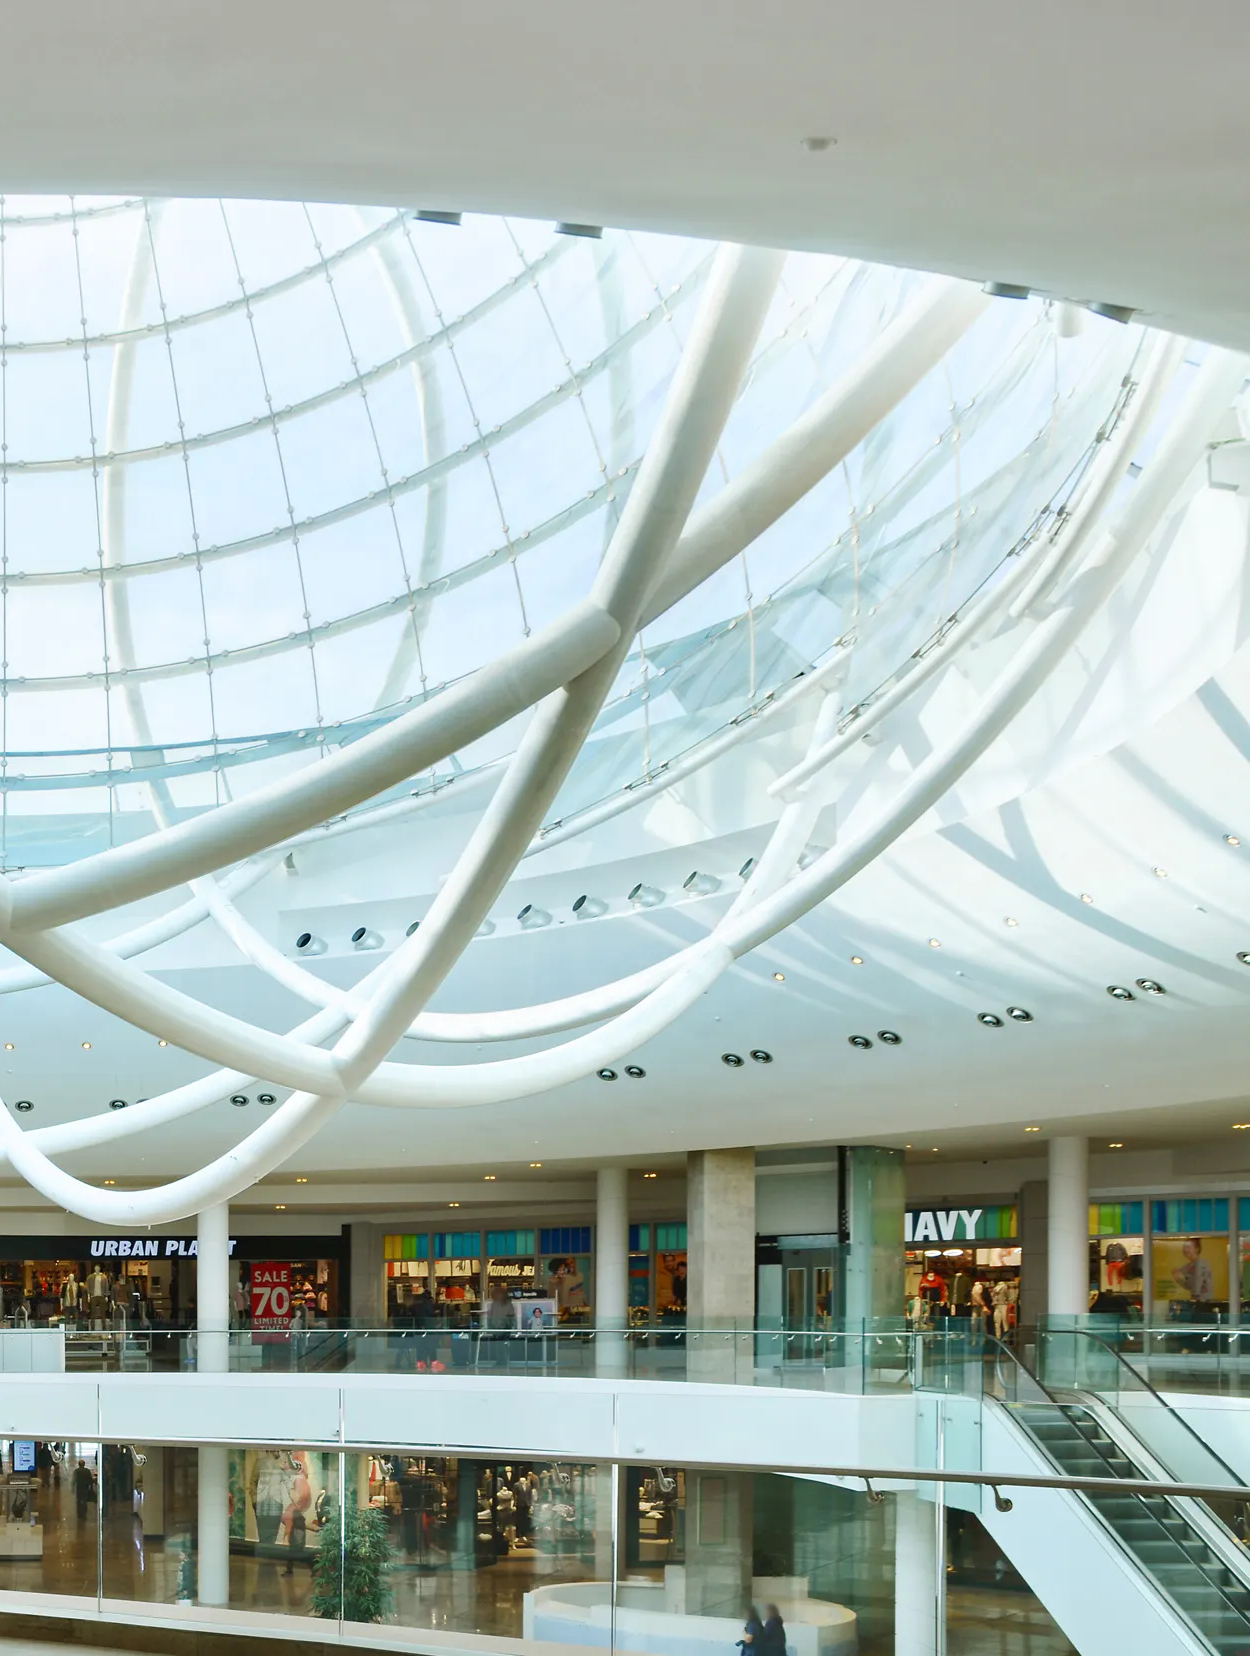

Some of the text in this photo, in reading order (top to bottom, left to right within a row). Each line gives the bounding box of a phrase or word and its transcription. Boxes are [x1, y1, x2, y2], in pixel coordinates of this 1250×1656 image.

[91, 1240, 237, 1257] URBAN PLAT
[254, 1270, 289, 1283] SALE
[252, 1286, 290, 1316] 70
[254, 1317, 289, 1325] LIMITED
